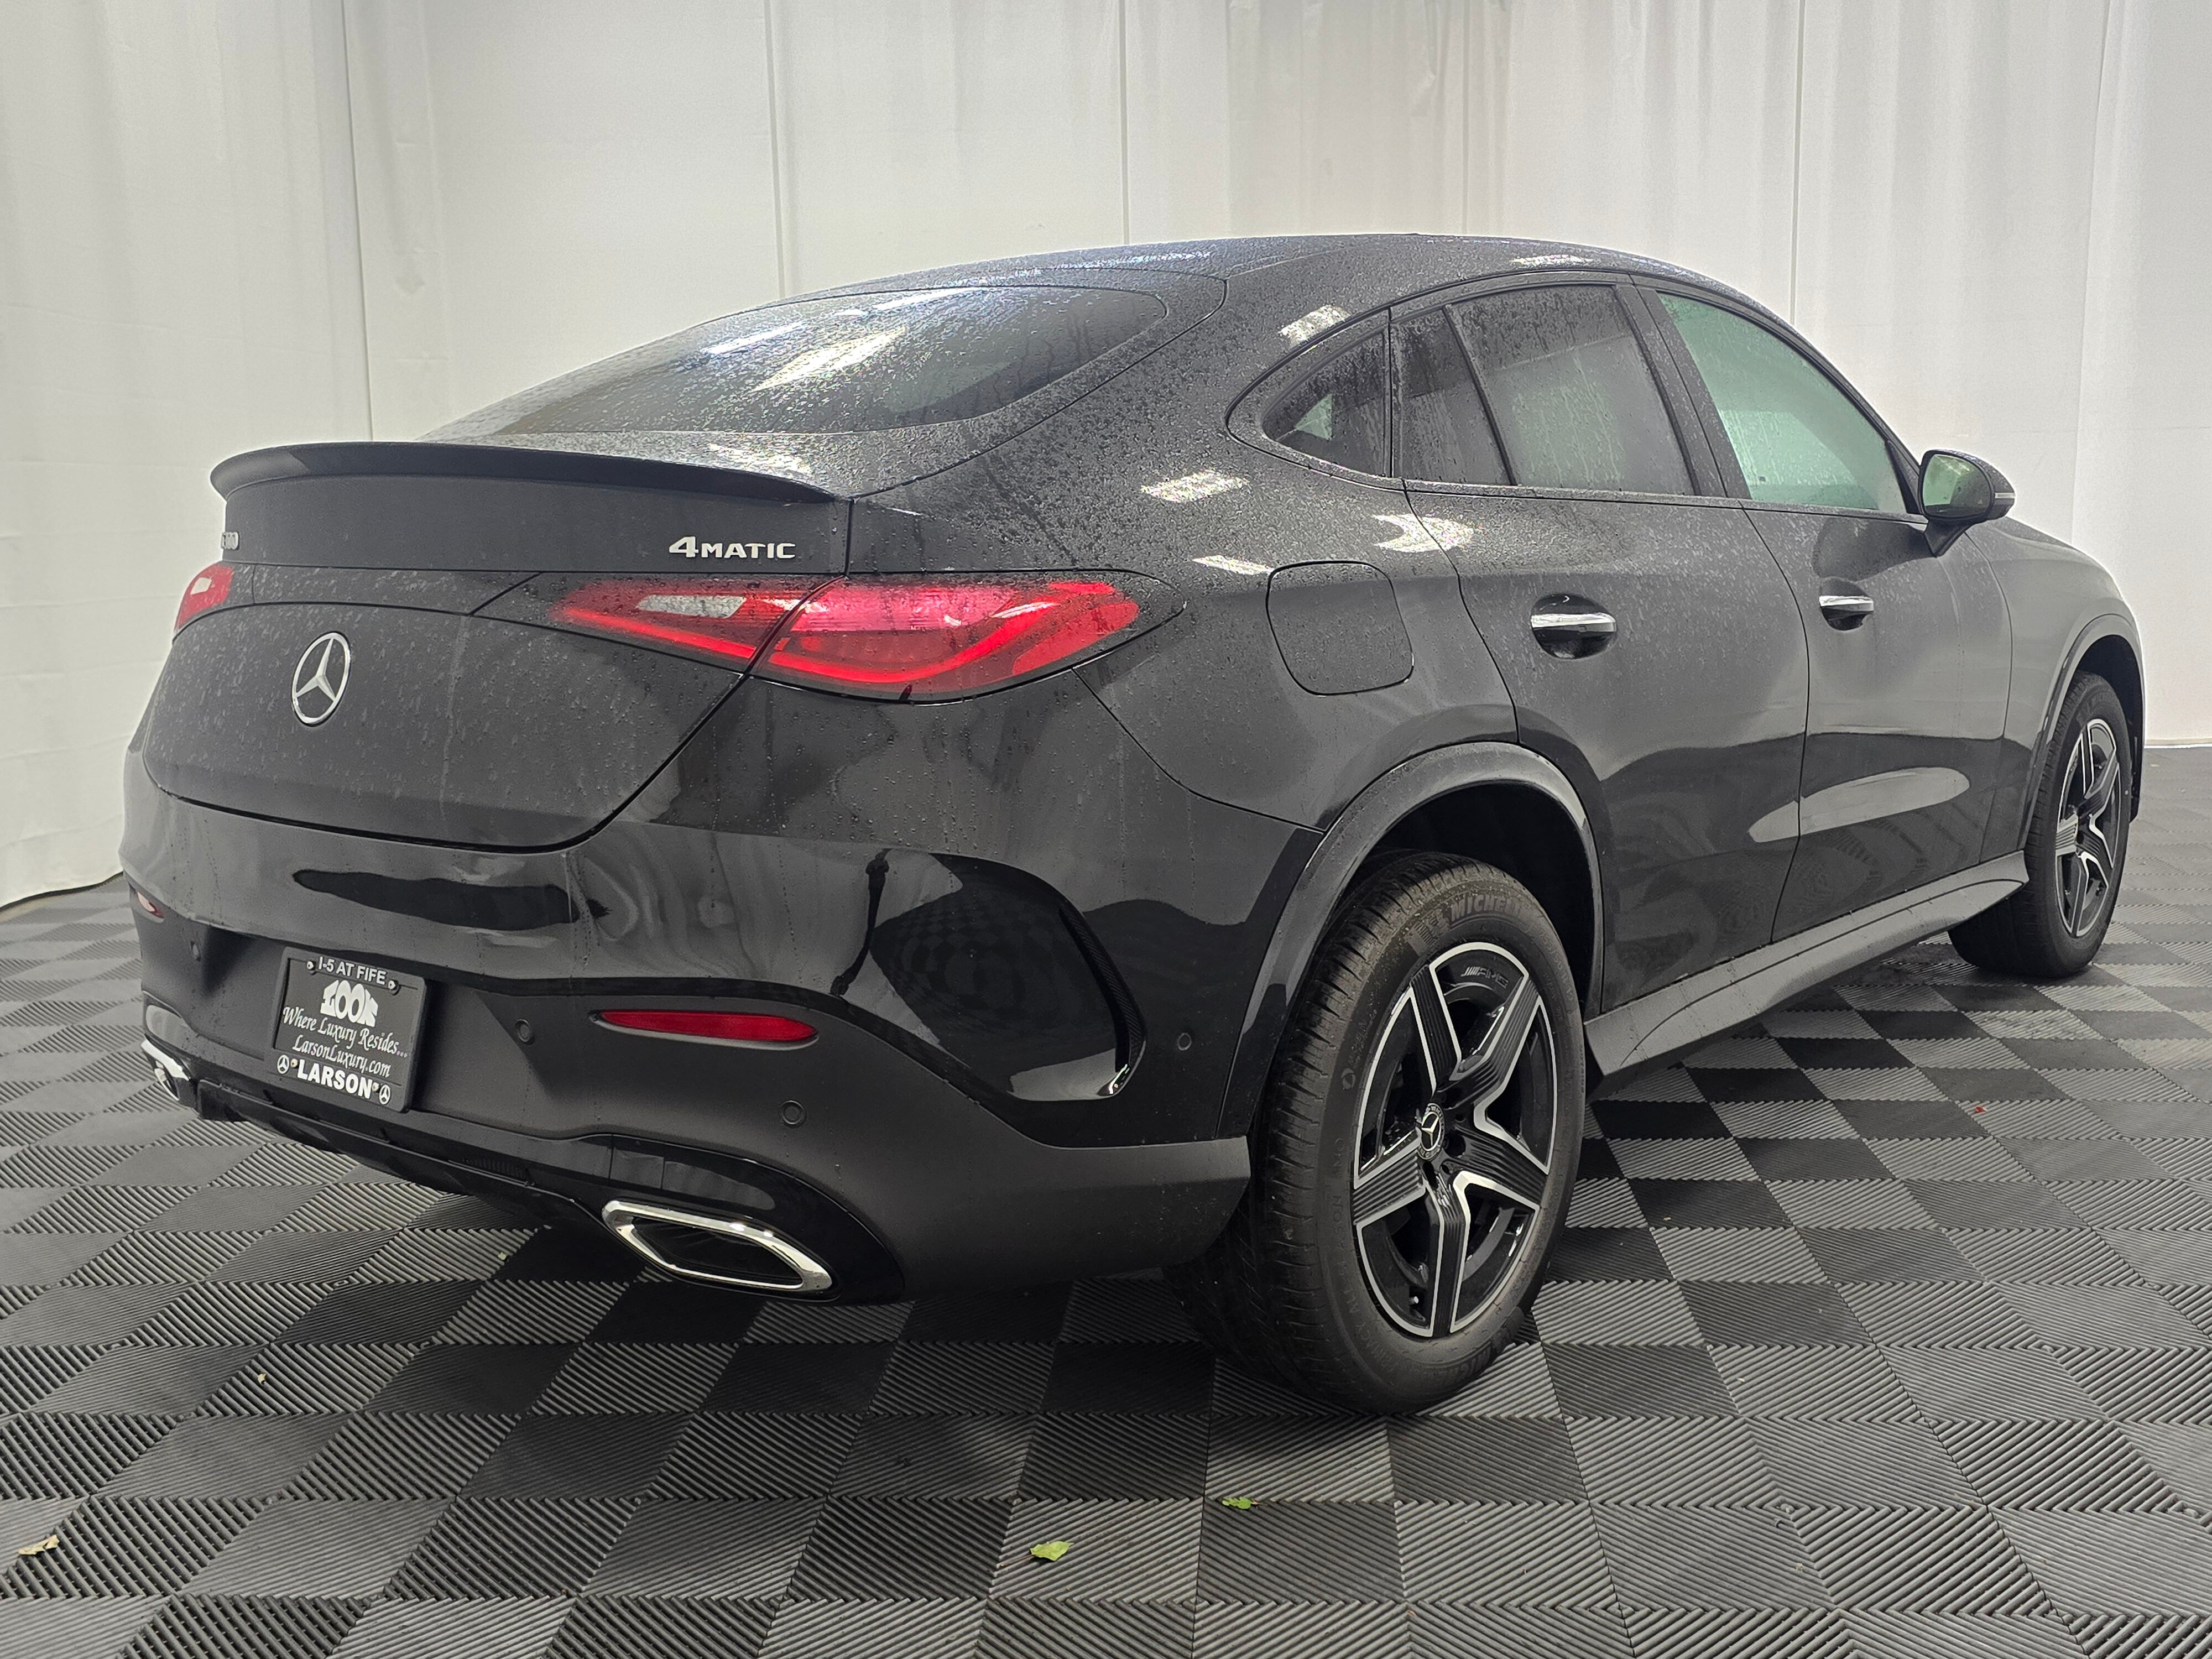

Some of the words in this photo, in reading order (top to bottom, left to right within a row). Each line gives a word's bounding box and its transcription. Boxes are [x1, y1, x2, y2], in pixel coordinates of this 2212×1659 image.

[669, 536, 796, 559] 4MATIC
[1451, 893, 1528, 924] MICHELI
[318, 956, 335, 972] I-5
[336, 961, 354, 977] AT
[356, 966, 386, 985] FIFE
[283, 1006, 317, 1031] Where
[317, 1017, 357, 1050] Luxury
[292, 1035, 391, 1077] LarsonLuxury.com
[297, 1059, 373, 1099] LARSON
